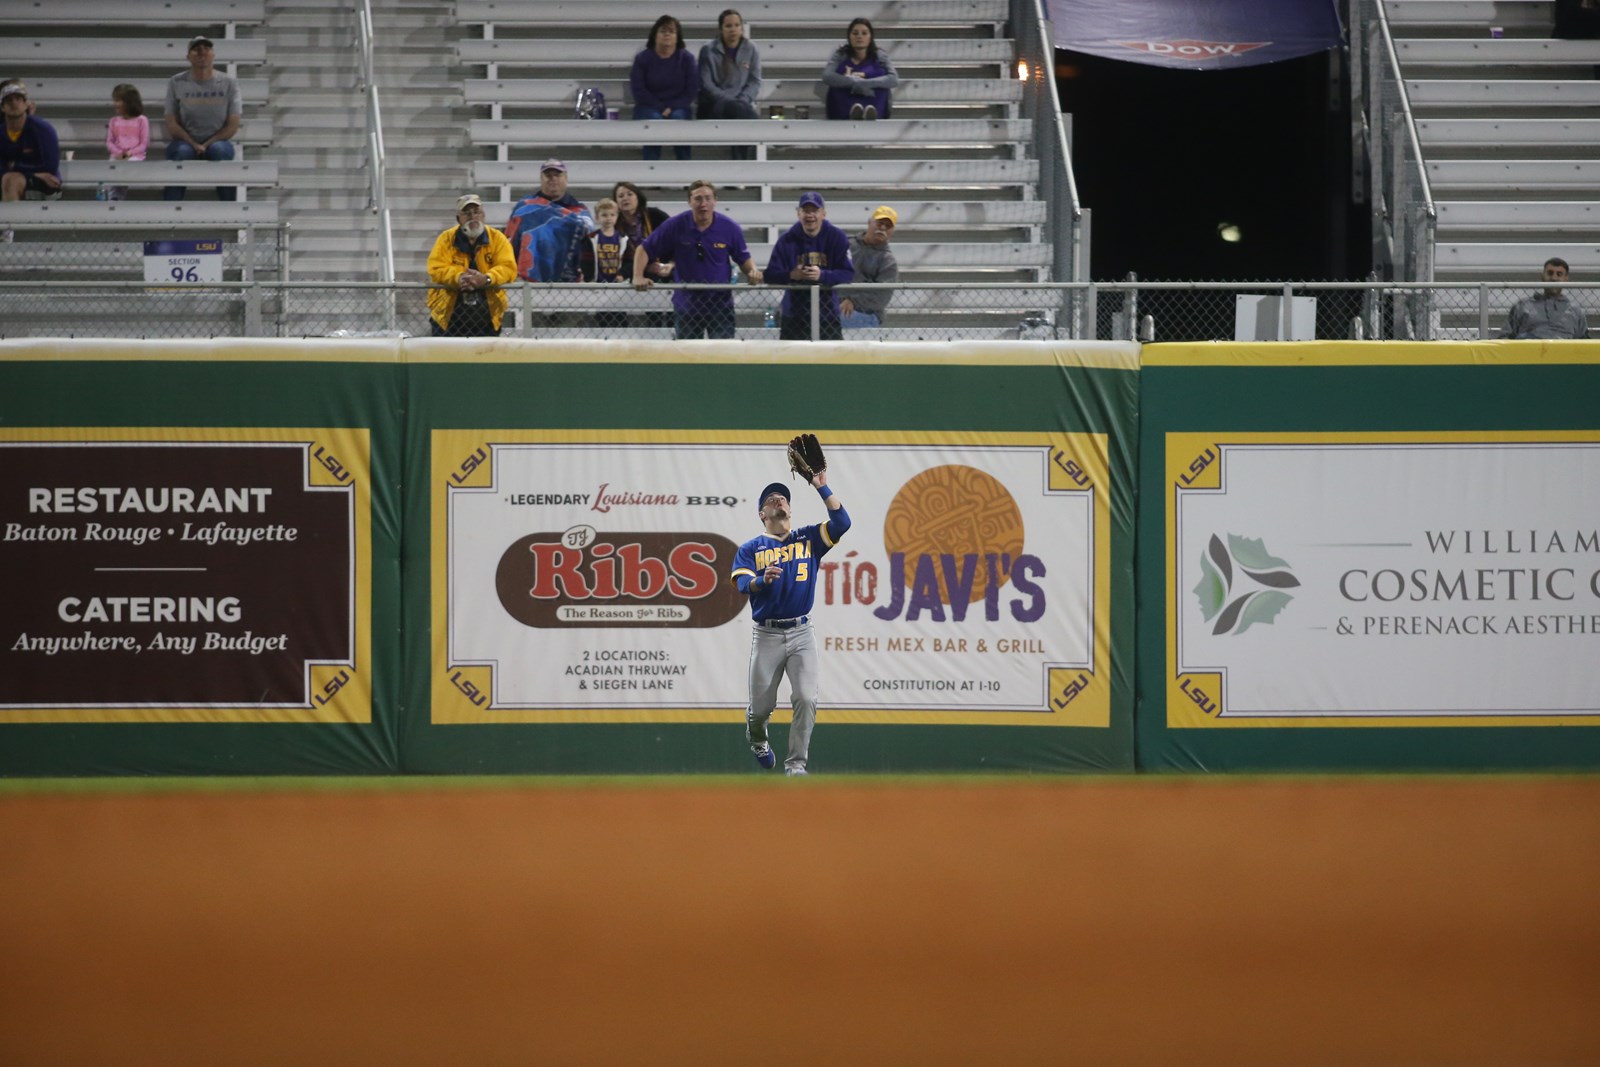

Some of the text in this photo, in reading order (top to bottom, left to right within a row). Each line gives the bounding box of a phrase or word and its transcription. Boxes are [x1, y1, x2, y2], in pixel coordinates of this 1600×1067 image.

[196, 243, 217, 251] LSU
[168, 258, 201, 266] SECTION
[171, 266, 199, 283] 96
[313, 446, 349, 482] LSU
[451, 447, 488, 484] LSU
[1053, 450, 1090, 486] LSU
[1180, 448, 1216, 485] LSU
[28, 487, 272, 513] RESTAURANT
[510, 483, 739, 513] LEGENDARY Louisiana BBQ
[3, 522, 298, 546] Baton Rouge Lafayette
[755, 540, 812, 571] HOFSTRA
[796, 563, 808, 581] 5
[1339, 567, 1575, 602] COSMETIC
[873, 552, 1047, 623] JAVI'S
[58, 597, 242, 623] CATERING
[564, 607, 586, 618] The
[589, 607, 634, 618] Reason
[657, 607, 683, 618] Ribs
[1336, 616, 1355, 635] &
[1363, 615, 1499, 635] PERENACK
[12, 631, 288, 655] Anywhere, Any Budget
[583, 650, 670, 661] 2 LOCATIONS:
[824, 637, 1046, 653] FRESH MEX BAR & GRILL
[565, 665, 687, 675] ACADIAN THRUWAY
[314, 670, 350, 705] LSU
[450, 671, 487, 706] LSU
[579, 679, 673, 690] & SIEGEN LANE
[863, 679, 1001, 692] CONSTITUTION AT I-10
[1053, 673, 1089, 709] LSU
[1179, 678, 1217, 714] LSU
